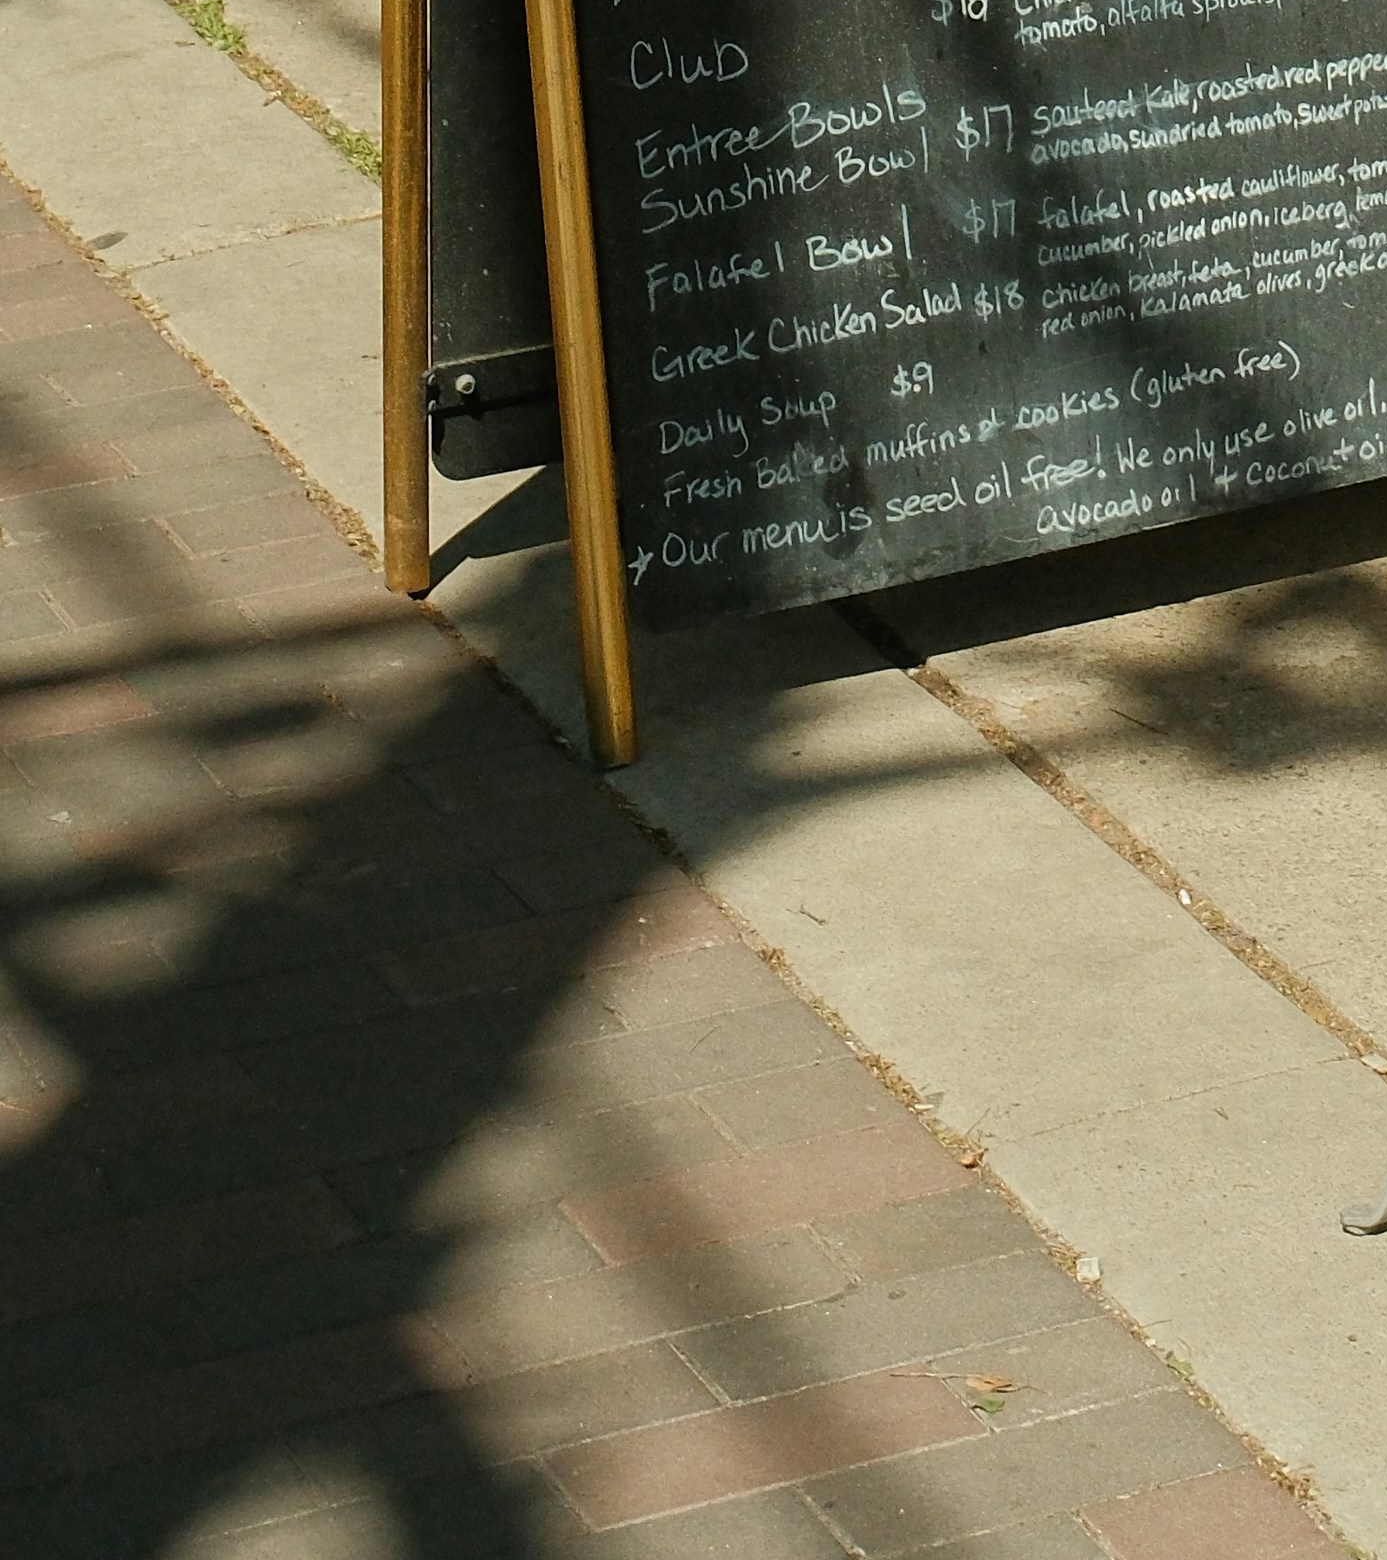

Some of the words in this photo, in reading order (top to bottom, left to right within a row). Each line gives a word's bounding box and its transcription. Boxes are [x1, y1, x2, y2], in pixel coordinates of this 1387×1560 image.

[629, 36, 749, 90] Club
[634, 122, 781, 179] Entree
[786, 77, 926, 150] Bowls
[639, 161, 829, 234] Sunshine
[833, 125, 929, 188] Bowl
[953, 102, 1014, 162] $17
[644, 239, 784, 312] Falafel
[804, 202, 913, 274] Bowl
[961, 197, 1016, 244] $17
[651, 327, 760, 382] Greek
[767, 301, 877, 354] Chicken
[876, 280, 962, 330] Salad
[973, 277, 1025, 324] $18
[658, 407, 749, 458] Daily
[759, 390, 836, 429] Soup
[662, 469, 742, 508] Fresh
[754, 435, 849, 489] Baked
[865, 420, 971, 469] muffins
[1011, 386, 1120, 431] cookies
[1129, 361, 1226, 409] (gluten
[1232, 339, 1301, 381] free)
[661, 530, 730, 567] Our
[741, 501, 841, 554] menu
[835, 501, 873, 533] is
[885, 475, 967, 522] seed
[974, 459, 1012, 505] oil
[1019, 433, 1108, 492] free!
[1114, 436, 1153, 474] We
[1161, 426, 1215, 484] only
[1224, 420, 1275, 457] use
[1282, 407, 1338, 438] olive
[1035, 487, 1153, 535] avocado
[1160, 472, 1196, 507] oil
